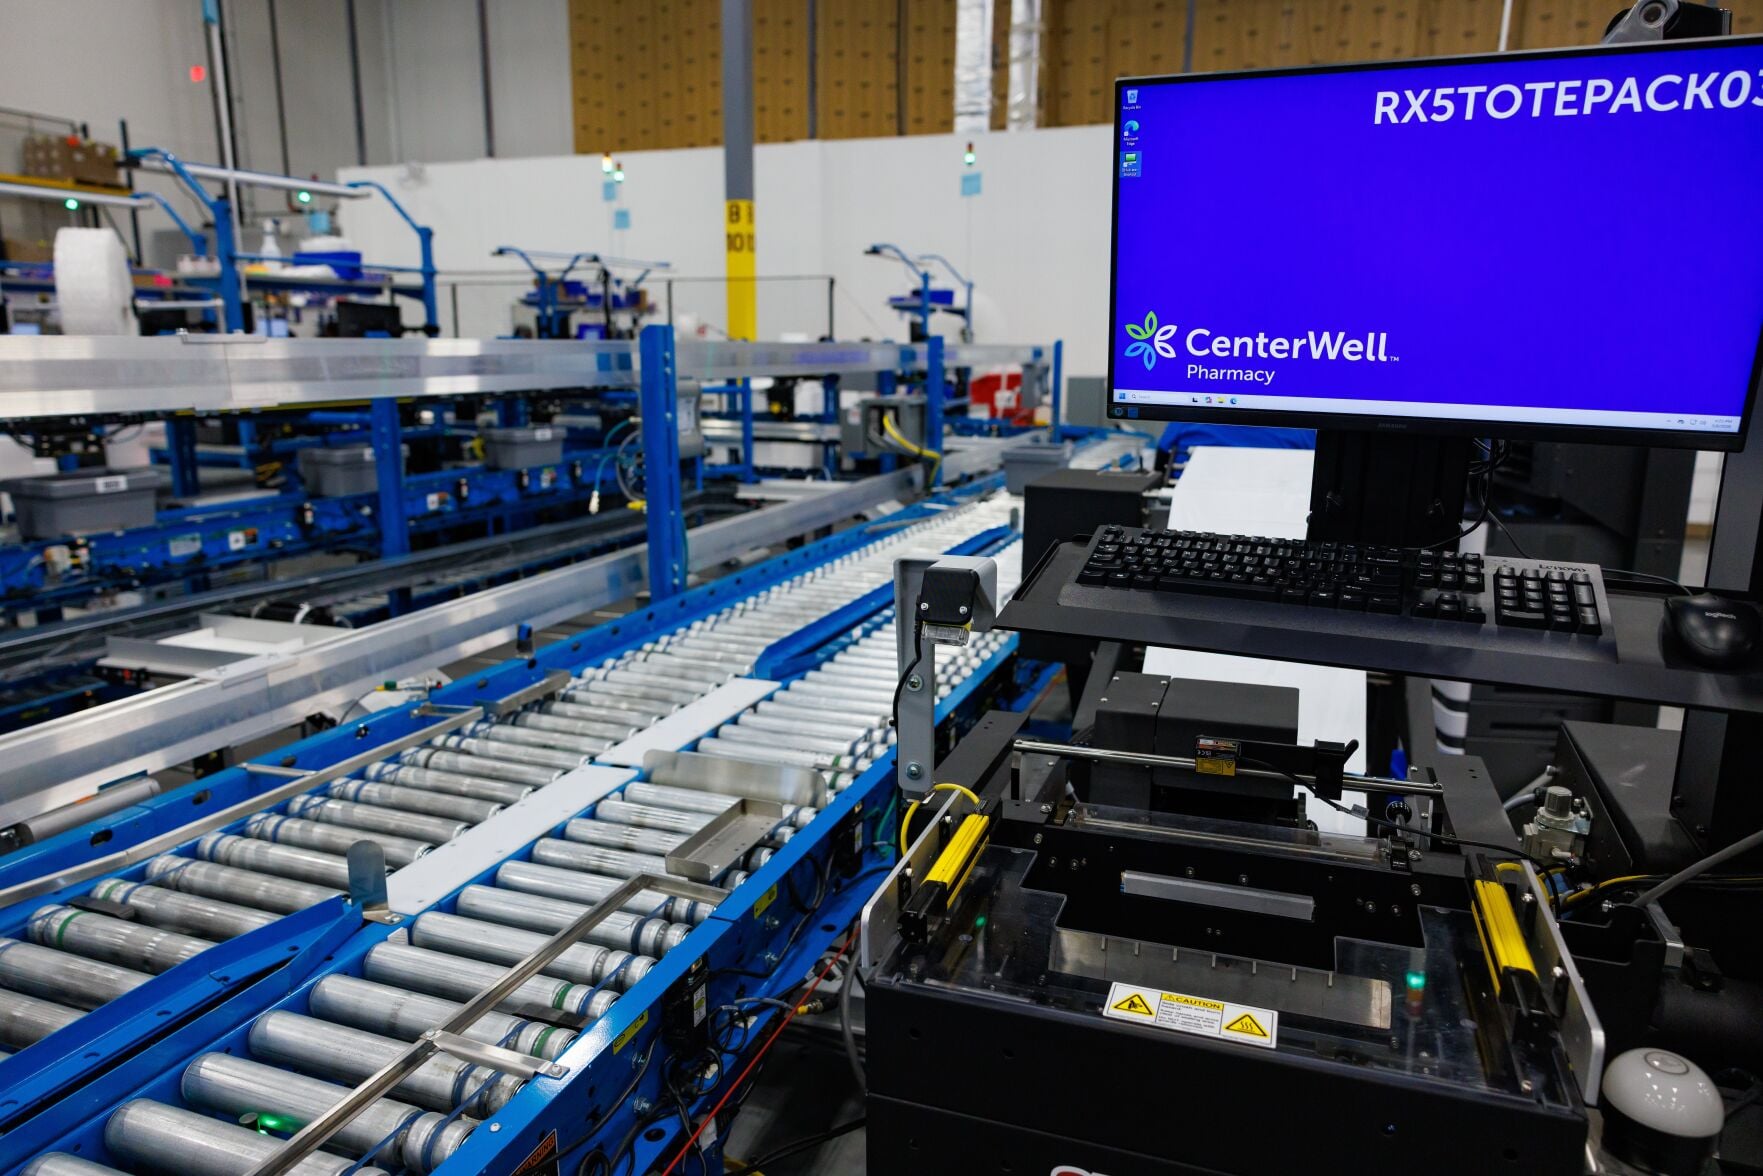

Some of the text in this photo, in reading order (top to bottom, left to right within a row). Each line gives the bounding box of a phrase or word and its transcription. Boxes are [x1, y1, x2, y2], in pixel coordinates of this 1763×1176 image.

[1185, 328, 1388, 362] CenterWell
[1187, 364, 1276, 386] Pharmacy
[1176, 997, 1220, 1009] CAUTION
